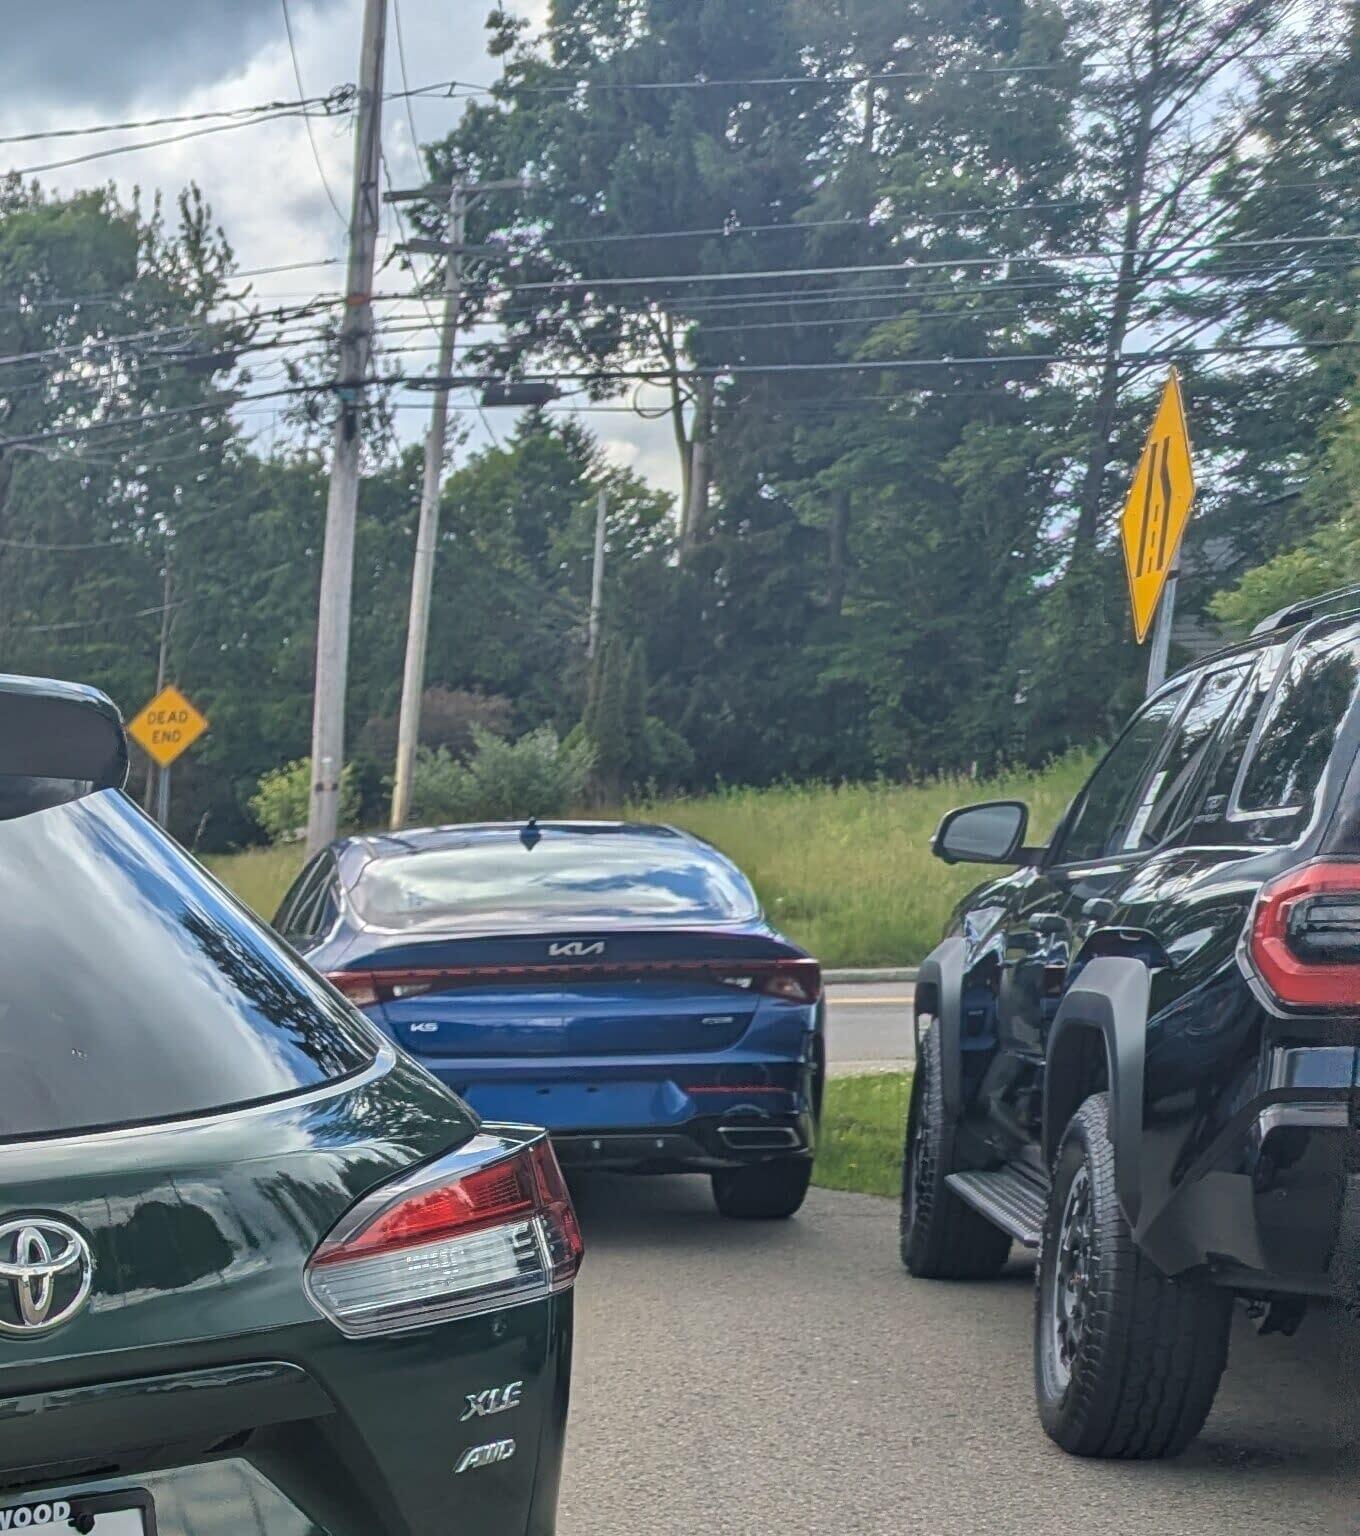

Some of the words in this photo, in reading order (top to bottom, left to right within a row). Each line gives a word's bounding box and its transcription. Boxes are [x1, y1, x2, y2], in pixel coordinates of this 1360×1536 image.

[147, 710, 188, 725] DEAD
[152, 729, 182, 744] END
[410, 1021, 439, 1033] K5
[459, 1380, 524, 1422] XLE
